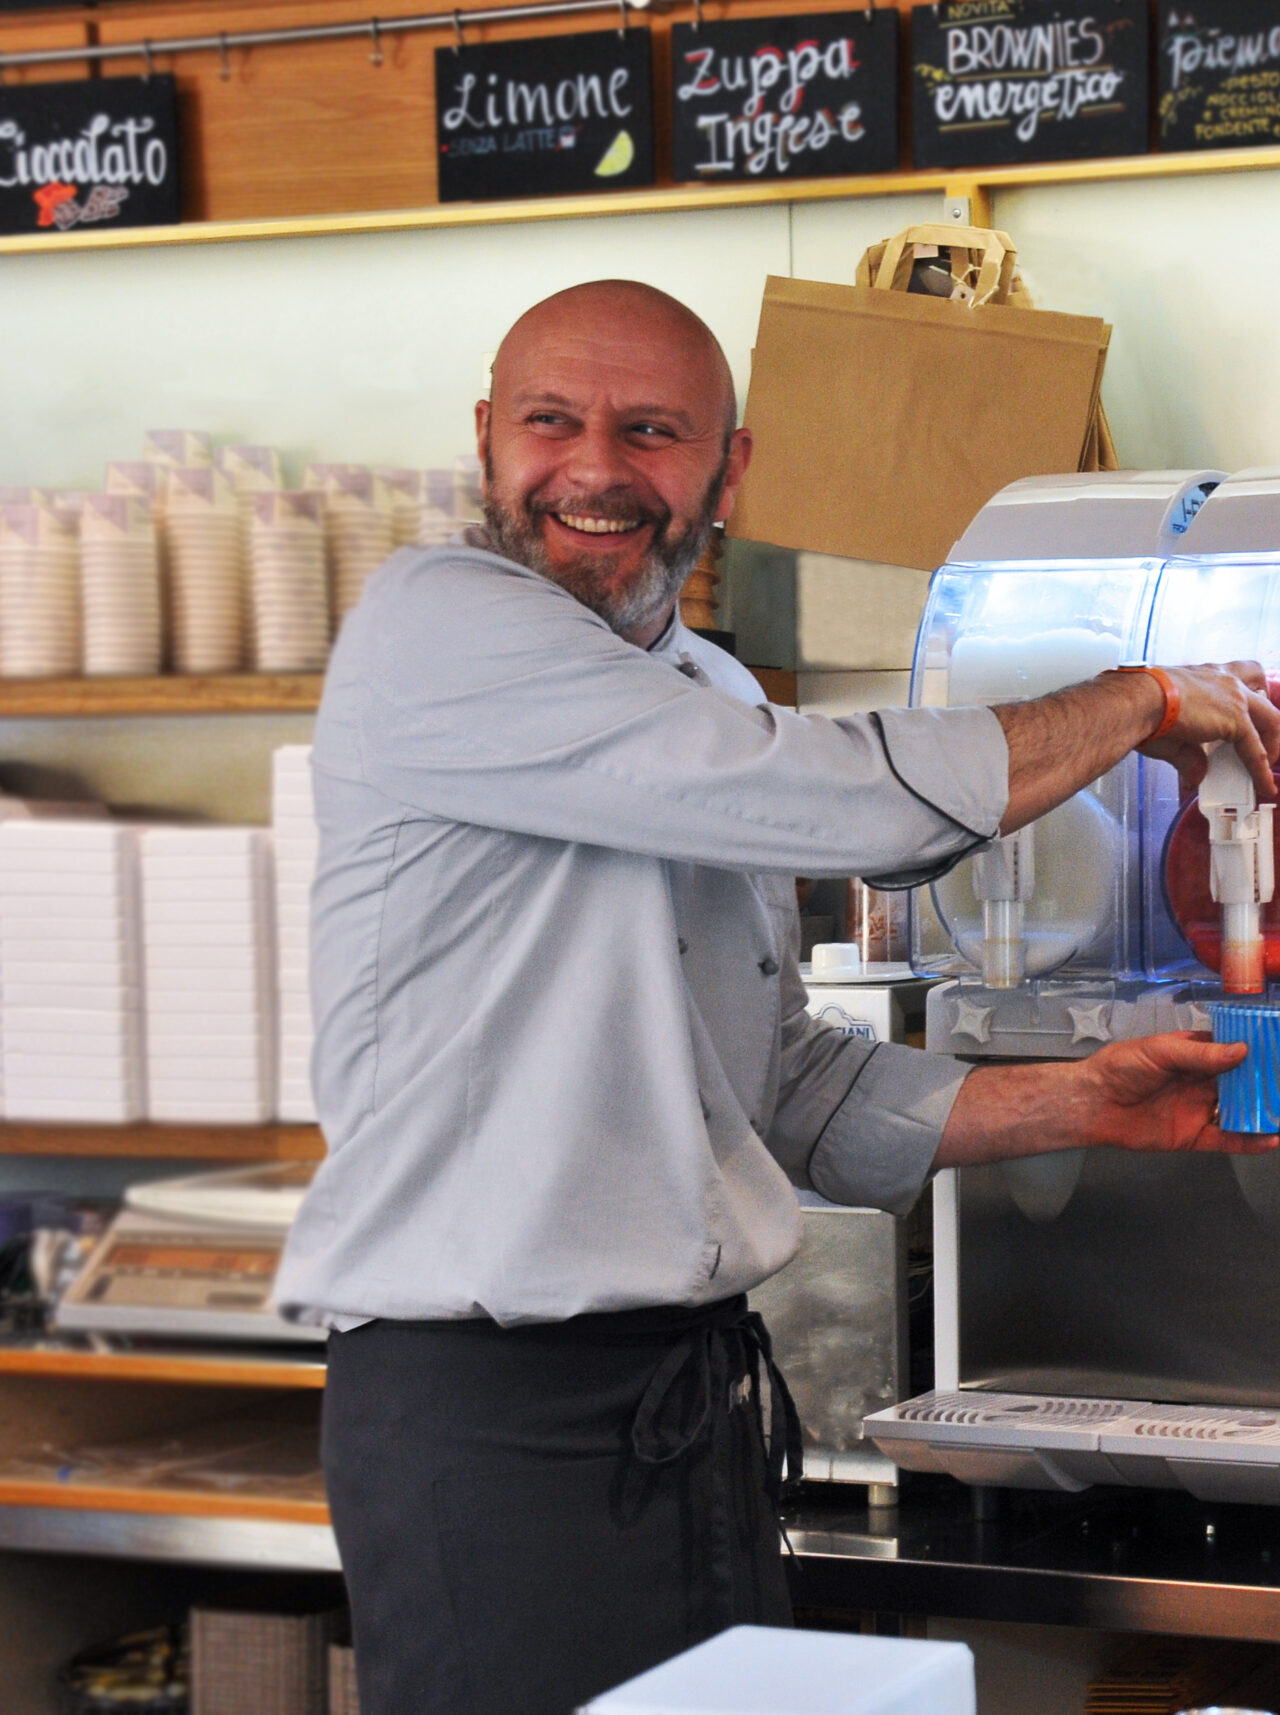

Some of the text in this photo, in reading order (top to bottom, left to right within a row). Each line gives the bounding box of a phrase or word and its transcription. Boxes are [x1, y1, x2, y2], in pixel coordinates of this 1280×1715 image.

[947, 12, 1103, 75] BROWNIES
[443, 67, 632, 130] Limone
[677, 38, 861, 117] Zuppa
[503, 128, 556, 152] LATTE
[694, 102, 866, 174] Inglese
